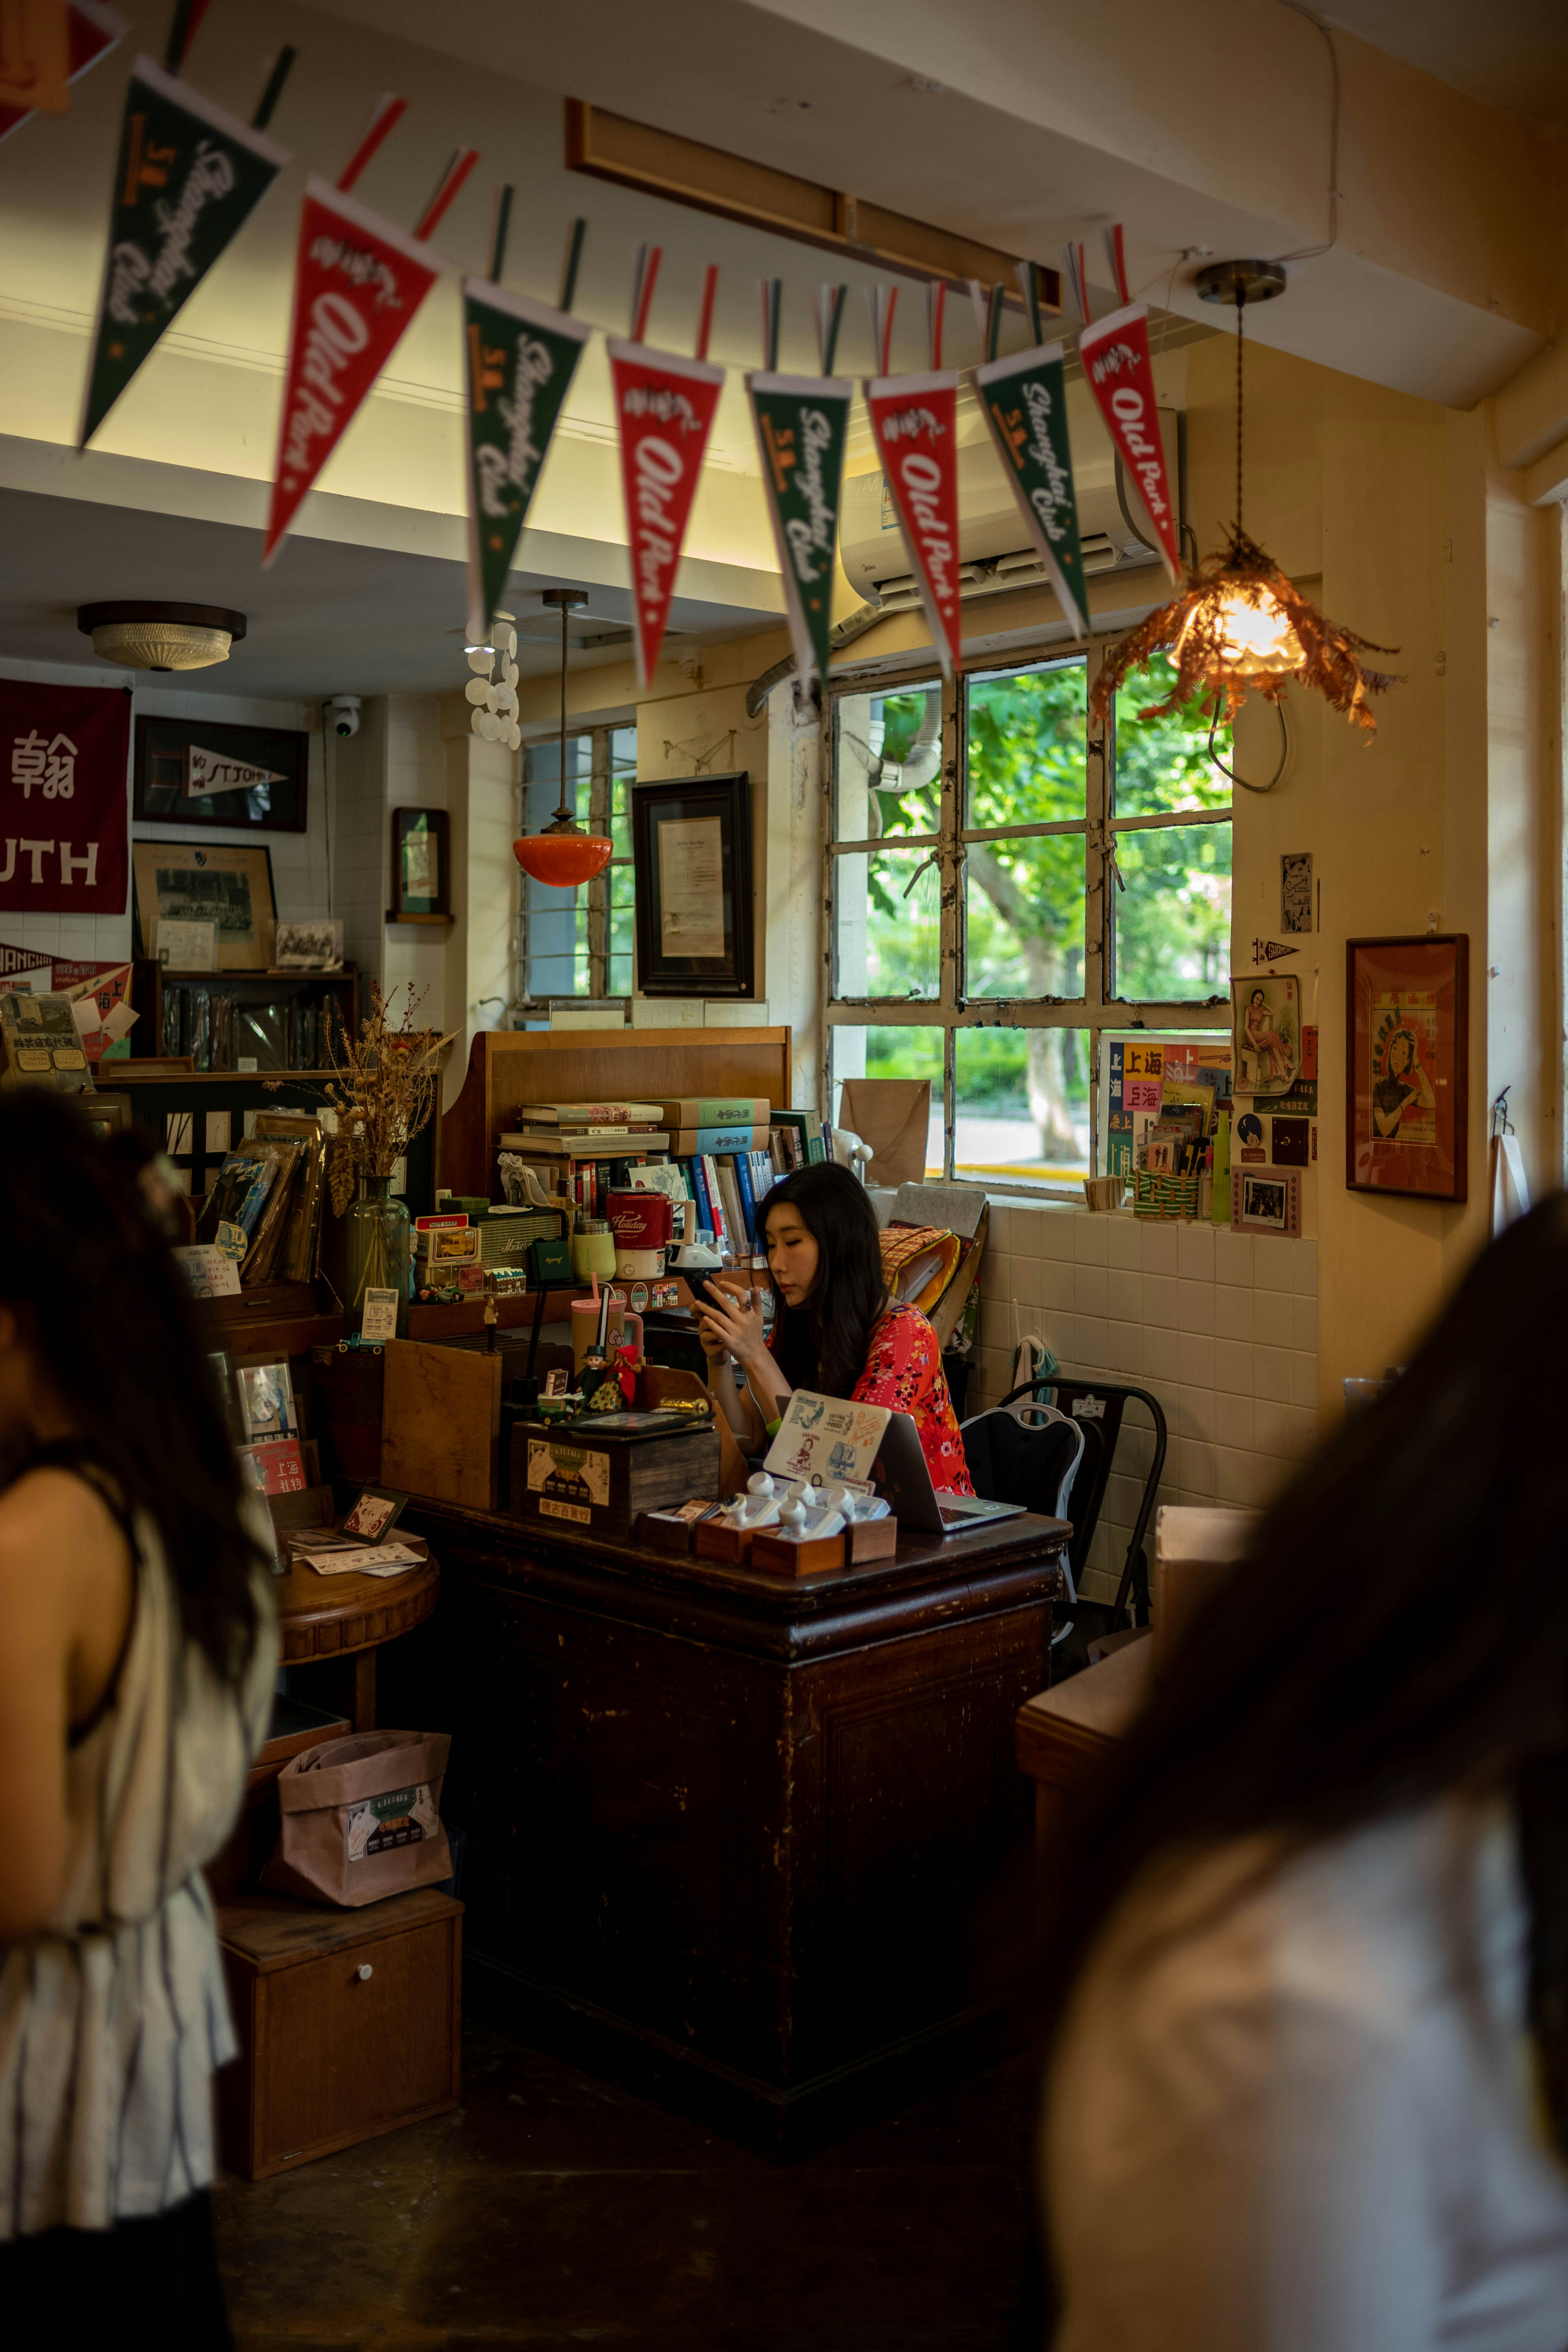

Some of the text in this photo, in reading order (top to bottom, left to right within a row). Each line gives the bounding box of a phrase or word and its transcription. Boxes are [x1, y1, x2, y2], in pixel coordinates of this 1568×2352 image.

[304, 292, 369, 406] Old
[1023, 381, 1073, 509] Shanghai
[1112, 387, 1167, 515] Old Park
[634, 435, 685, 601] Old Park
[901, 453, 953, 598] Old Park
[1031, 486, 1066, 541] Club
[11, 728, 79, 800] 翰
[1125, 1050, 1162, 1076] 上海
[1294, 1084, 1314, 1096] PARK
[612, 1214, 647, 1233] Holiday
[277, 1461, 299, 1477] 上海
